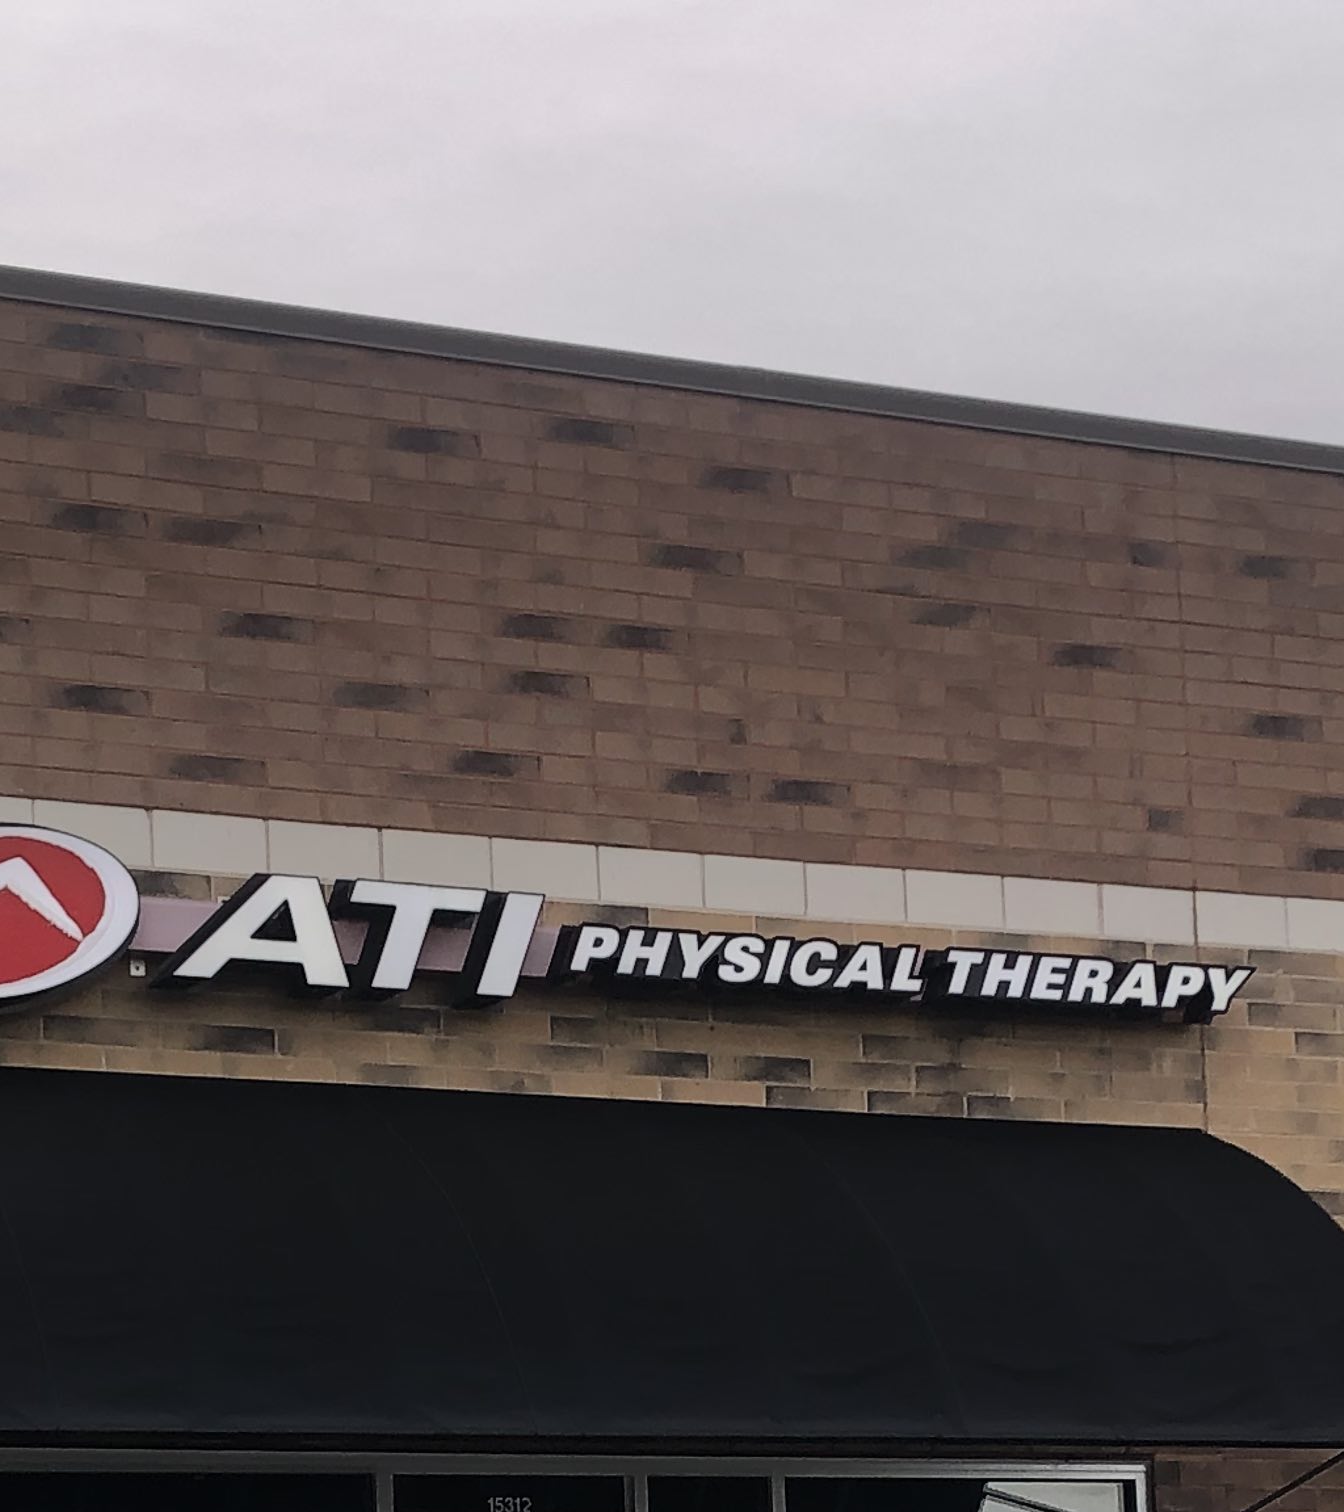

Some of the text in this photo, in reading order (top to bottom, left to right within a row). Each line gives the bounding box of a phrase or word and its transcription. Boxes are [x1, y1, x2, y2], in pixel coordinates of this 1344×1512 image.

[170, 874, 546, 998] ATI
[570, 925, 1254, 1012] PHYSICAL THERAPY
